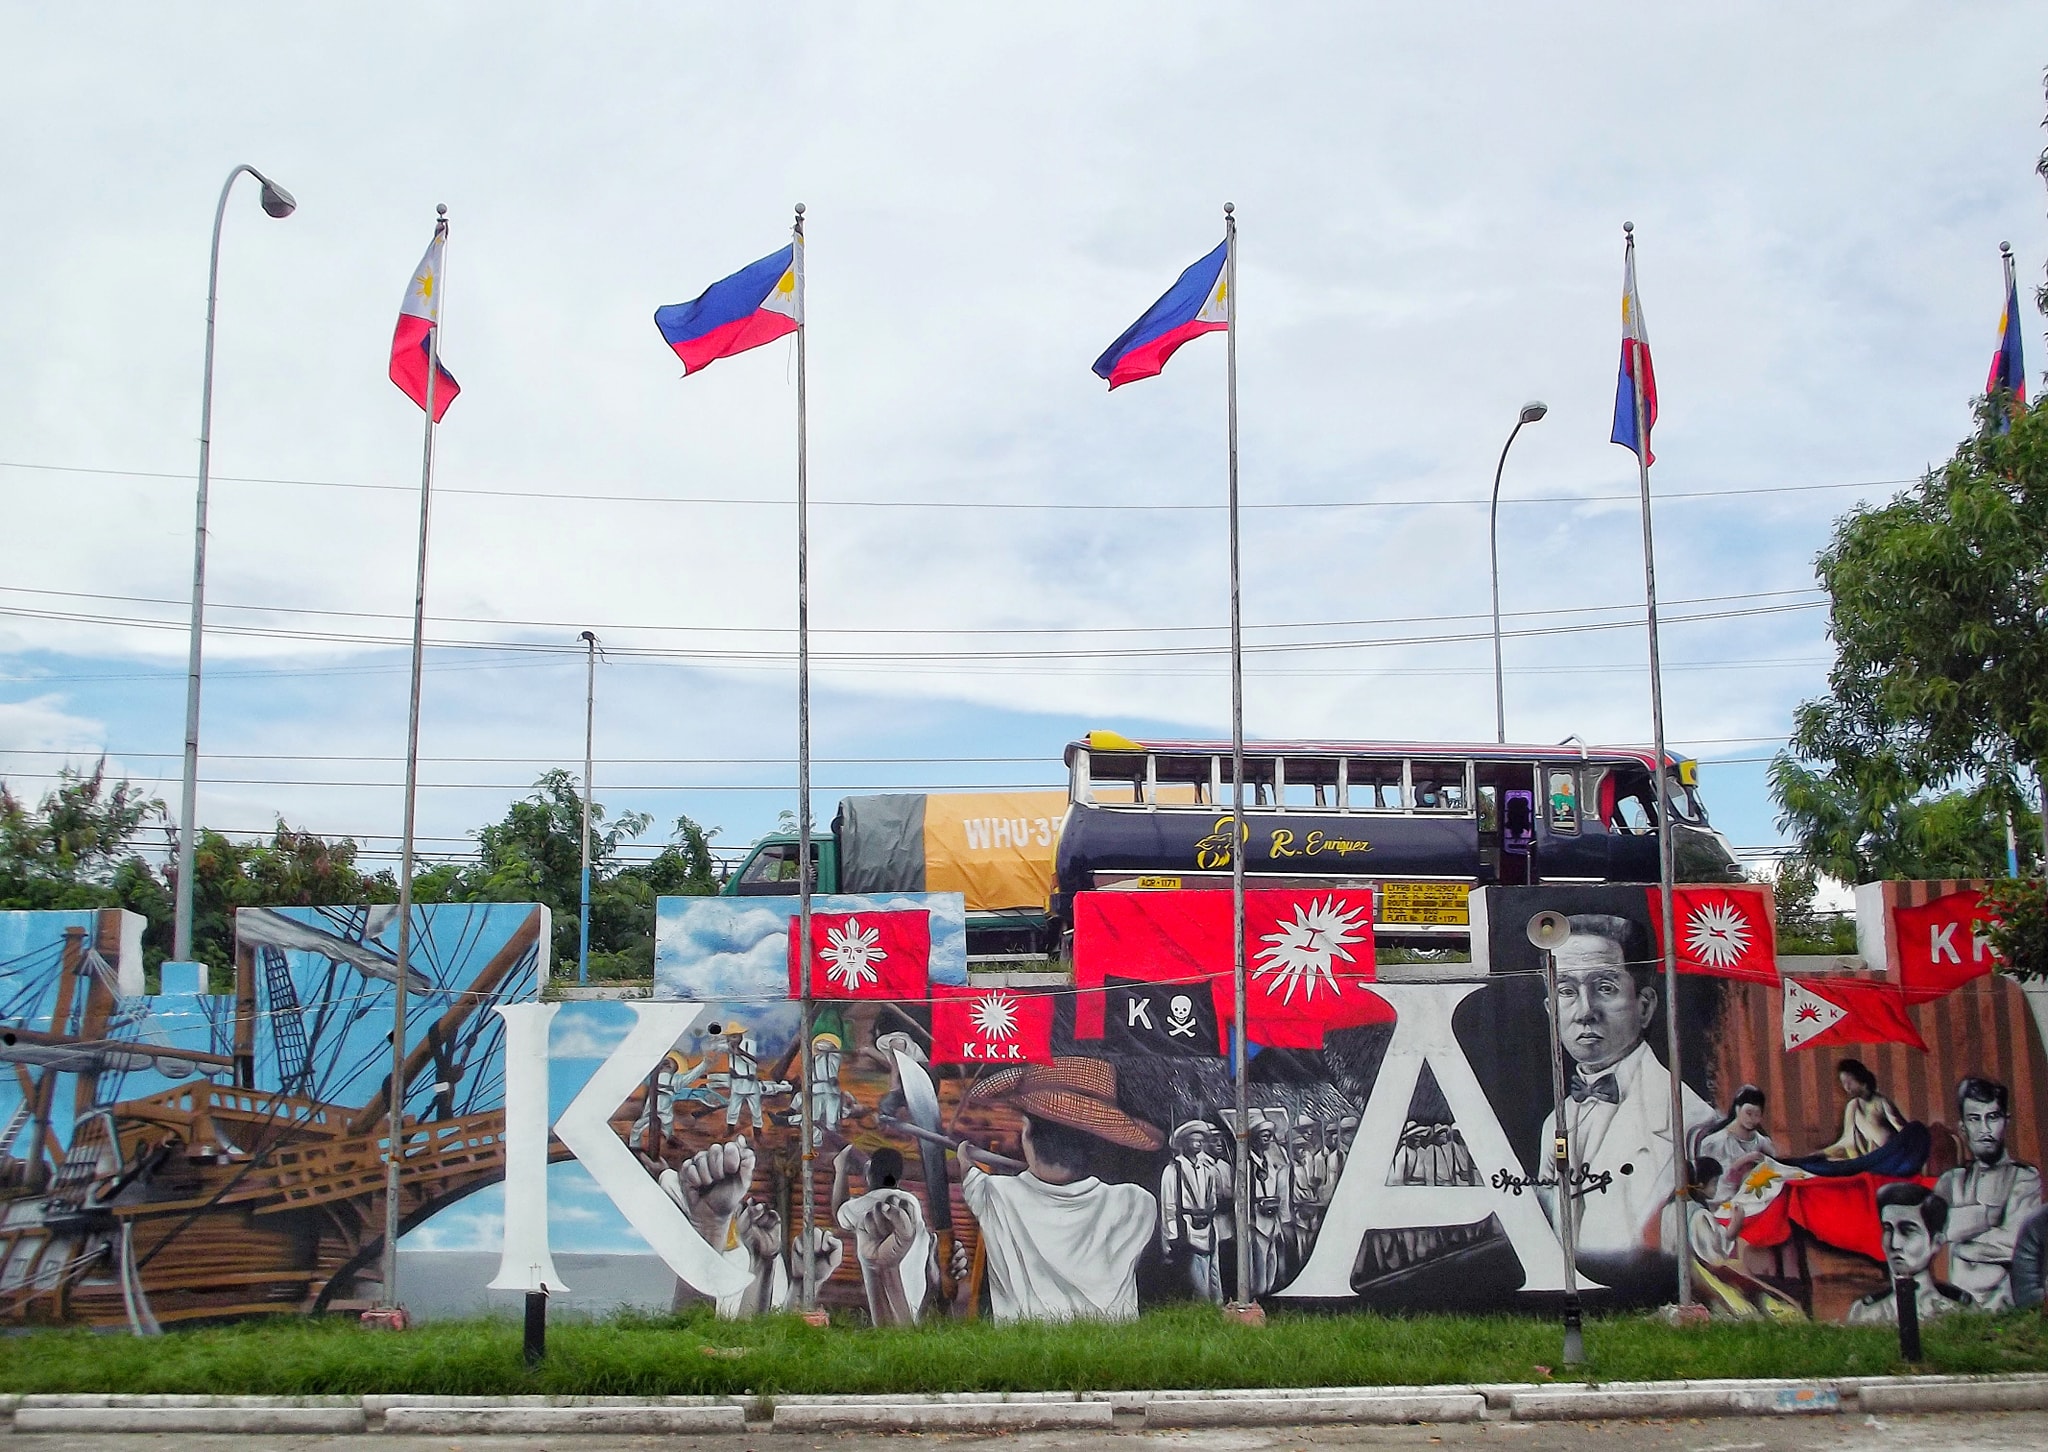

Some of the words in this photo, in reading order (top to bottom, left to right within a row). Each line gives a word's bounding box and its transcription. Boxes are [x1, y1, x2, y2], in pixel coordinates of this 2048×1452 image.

[1269, 829, 1302, 859] R.
[1305, 830, 1375, 857] Enriquez
[1790, 988, 1797, 997] K
[1127, 998, 1153, 1030] K
[1830, 1009, 1838, 1019] K
[1790, 1033, 1800, 1043] K
